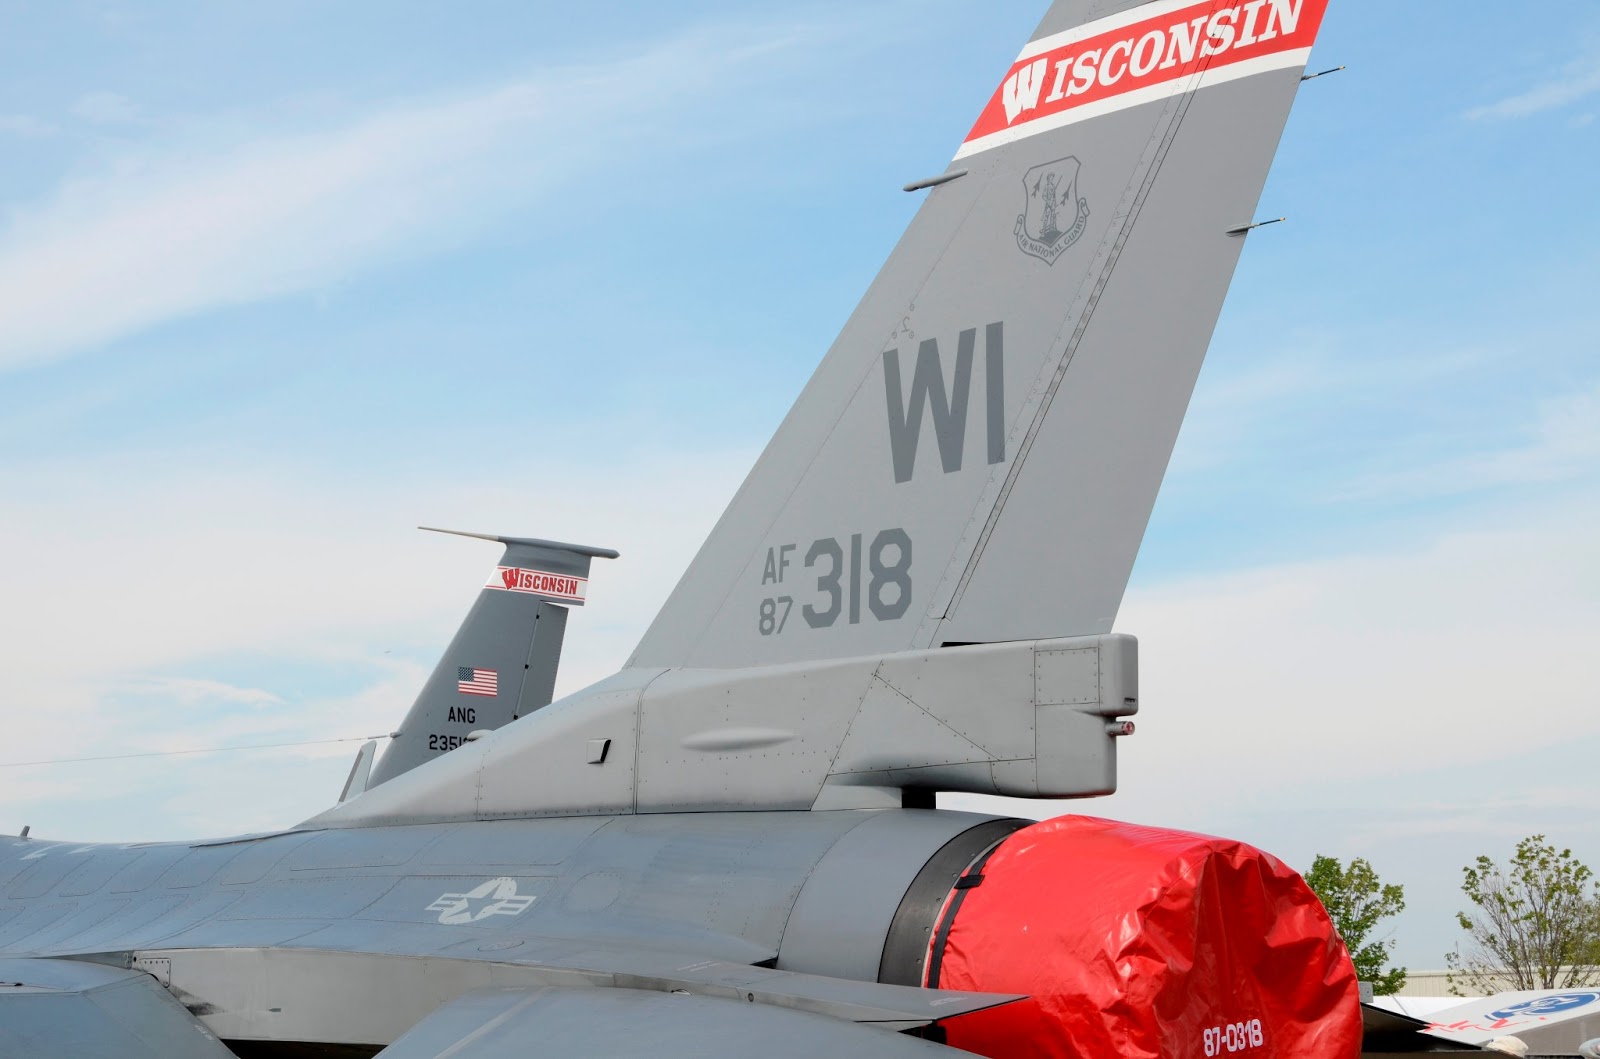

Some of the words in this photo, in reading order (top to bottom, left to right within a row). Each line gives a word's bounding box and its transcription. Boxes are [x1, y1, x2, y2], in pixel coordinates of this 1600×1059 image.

[1001, 0, 1304, 125] WISCONSIN
[1028, 242, 1063, 258] NATIONAL
[1063, 215, 1085, 246] GUARD
[882, 320, 1006, 485] WI
[501, 567, 579, 595] WISCONSIN
[761, 543, 797, 586] AF
[802, 527, 913, 629] 318
[758, 595, 794, 636] 87
[447, 706, 476, 724] ANG
[429, 734, 468, 751] 2351
[1203, 1018, 1264, 1057] 87-0318
